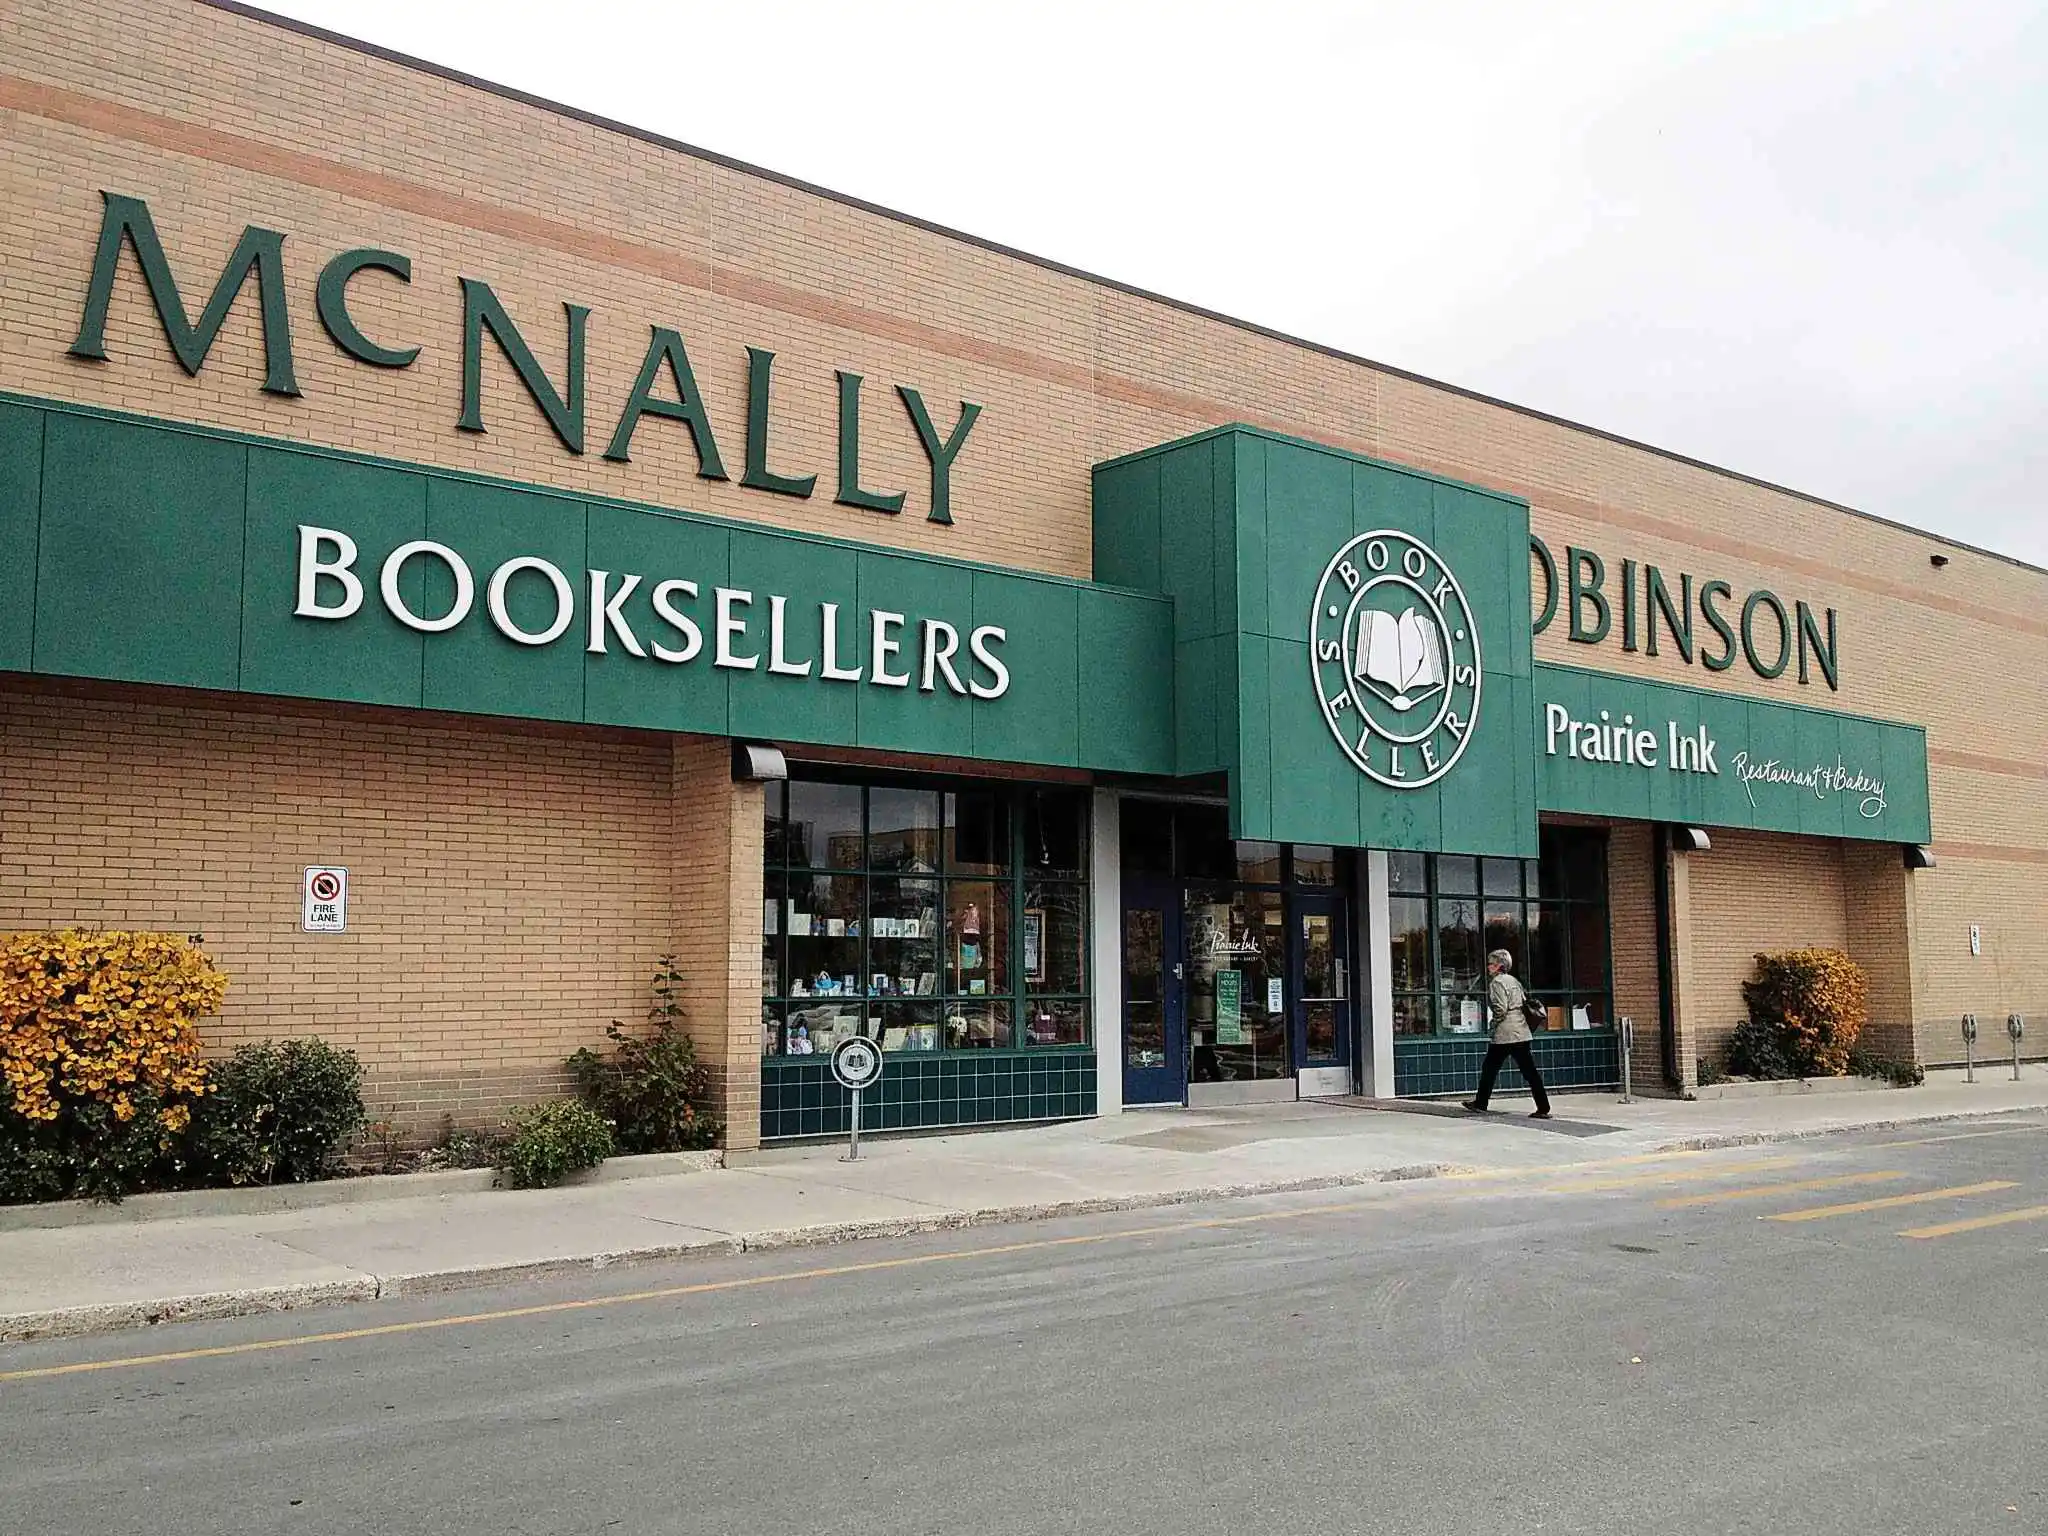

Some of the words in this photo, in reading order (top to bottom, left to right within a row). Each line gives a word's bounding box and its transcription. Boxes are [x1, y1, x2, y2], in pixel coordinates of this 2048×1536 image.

[66, 189, 982, 526] MCNALLY
[1337, 540, 1454, 610] BOOK
[294, 524, 1012, 700] BOOKSELLERS
[1318, 638, 1476, 778] SELLERS
[1544, 702, 1658, 768] Prairie
[1668, 719, 1720, 775] Ink
[1731, 751, 1825, 809] Restaurant
[1833, 753, 1888, 818] Bakery
[310, 913, 339, 922] LANE
[313, 904, 336, 913] FIRE
